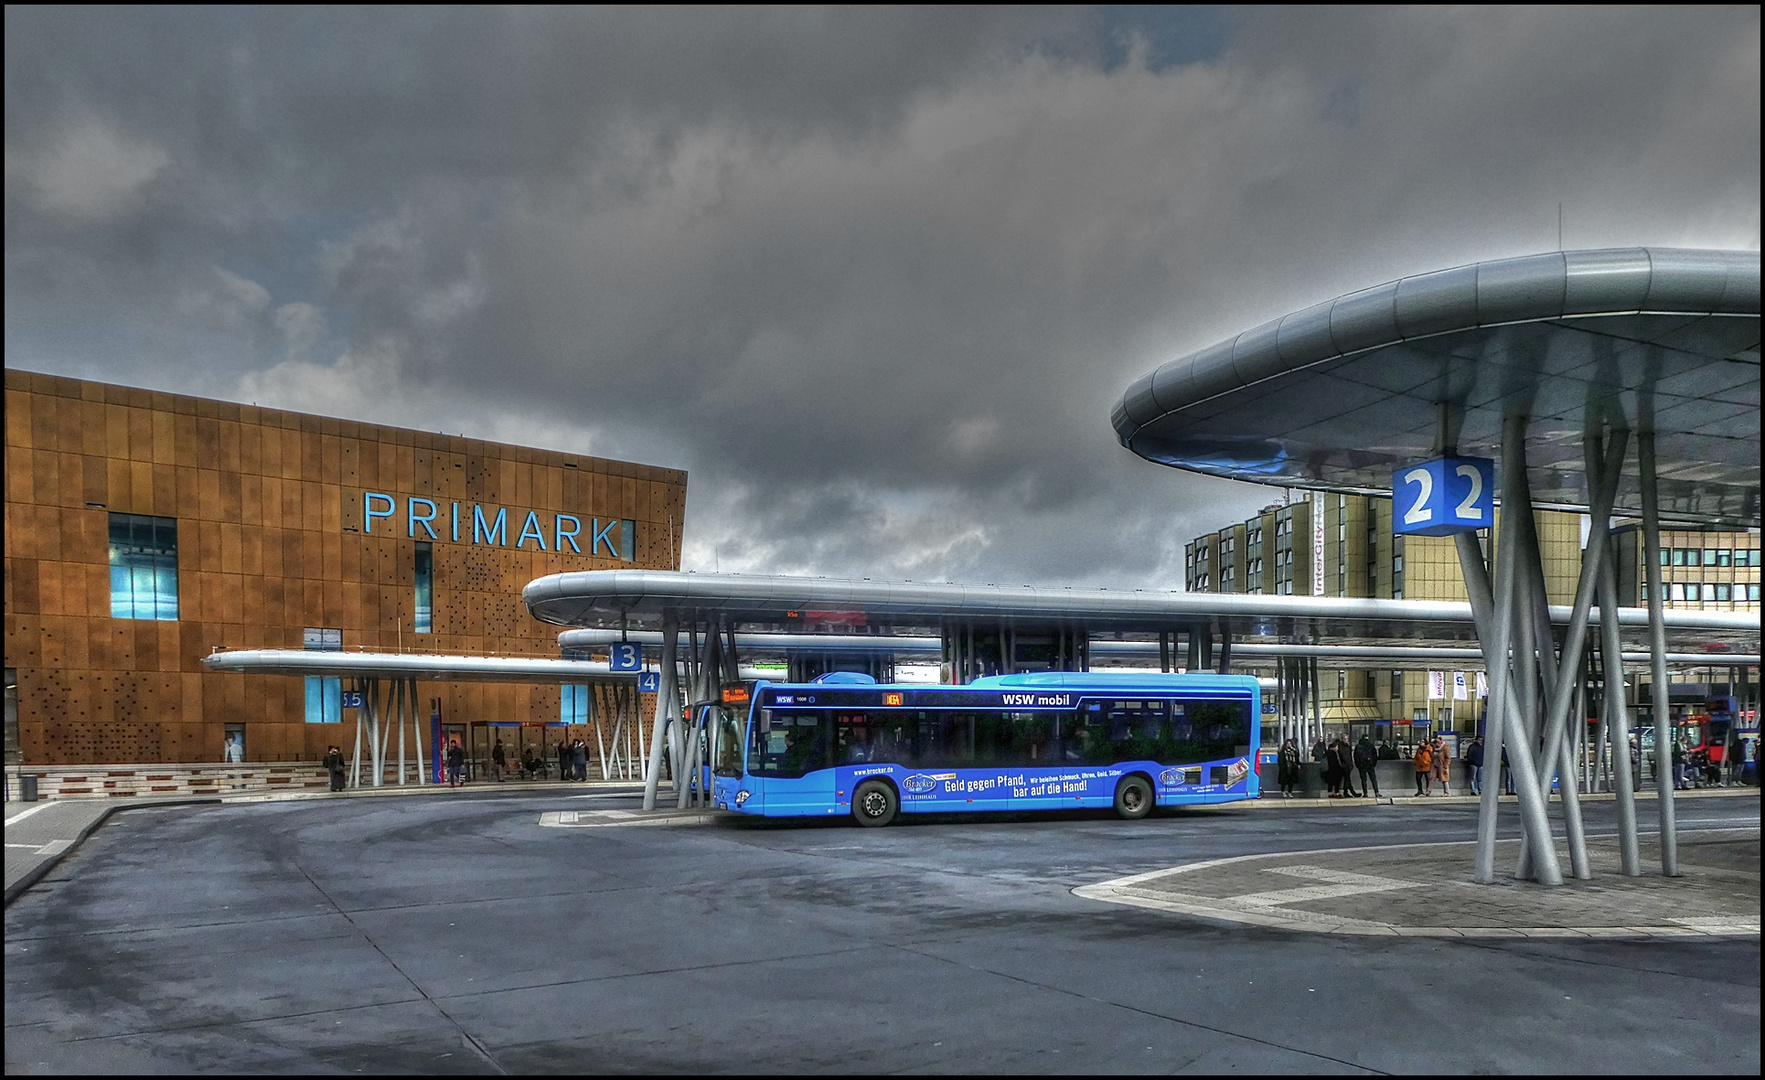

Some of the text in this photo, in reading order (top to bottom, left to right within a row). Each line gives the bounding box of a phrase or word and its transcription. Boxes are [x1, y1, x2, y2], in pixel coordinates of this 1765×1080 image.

[1404, 468, 1432, 525] 2
[1455, 464, 1482, 519] 2
[364, 492, 619, 557] PRIMARK
[621, 645, 636, 667] 3
[644, 674, 655, 690] 4
[352, 692, 361, 706] 5
[1003, 694, 1070, 705] WSW mobil
[945, 774, 1027, 793] Geld gegen Pfand,
[1013, 780, 1087, 797] bar auf die Hand!
